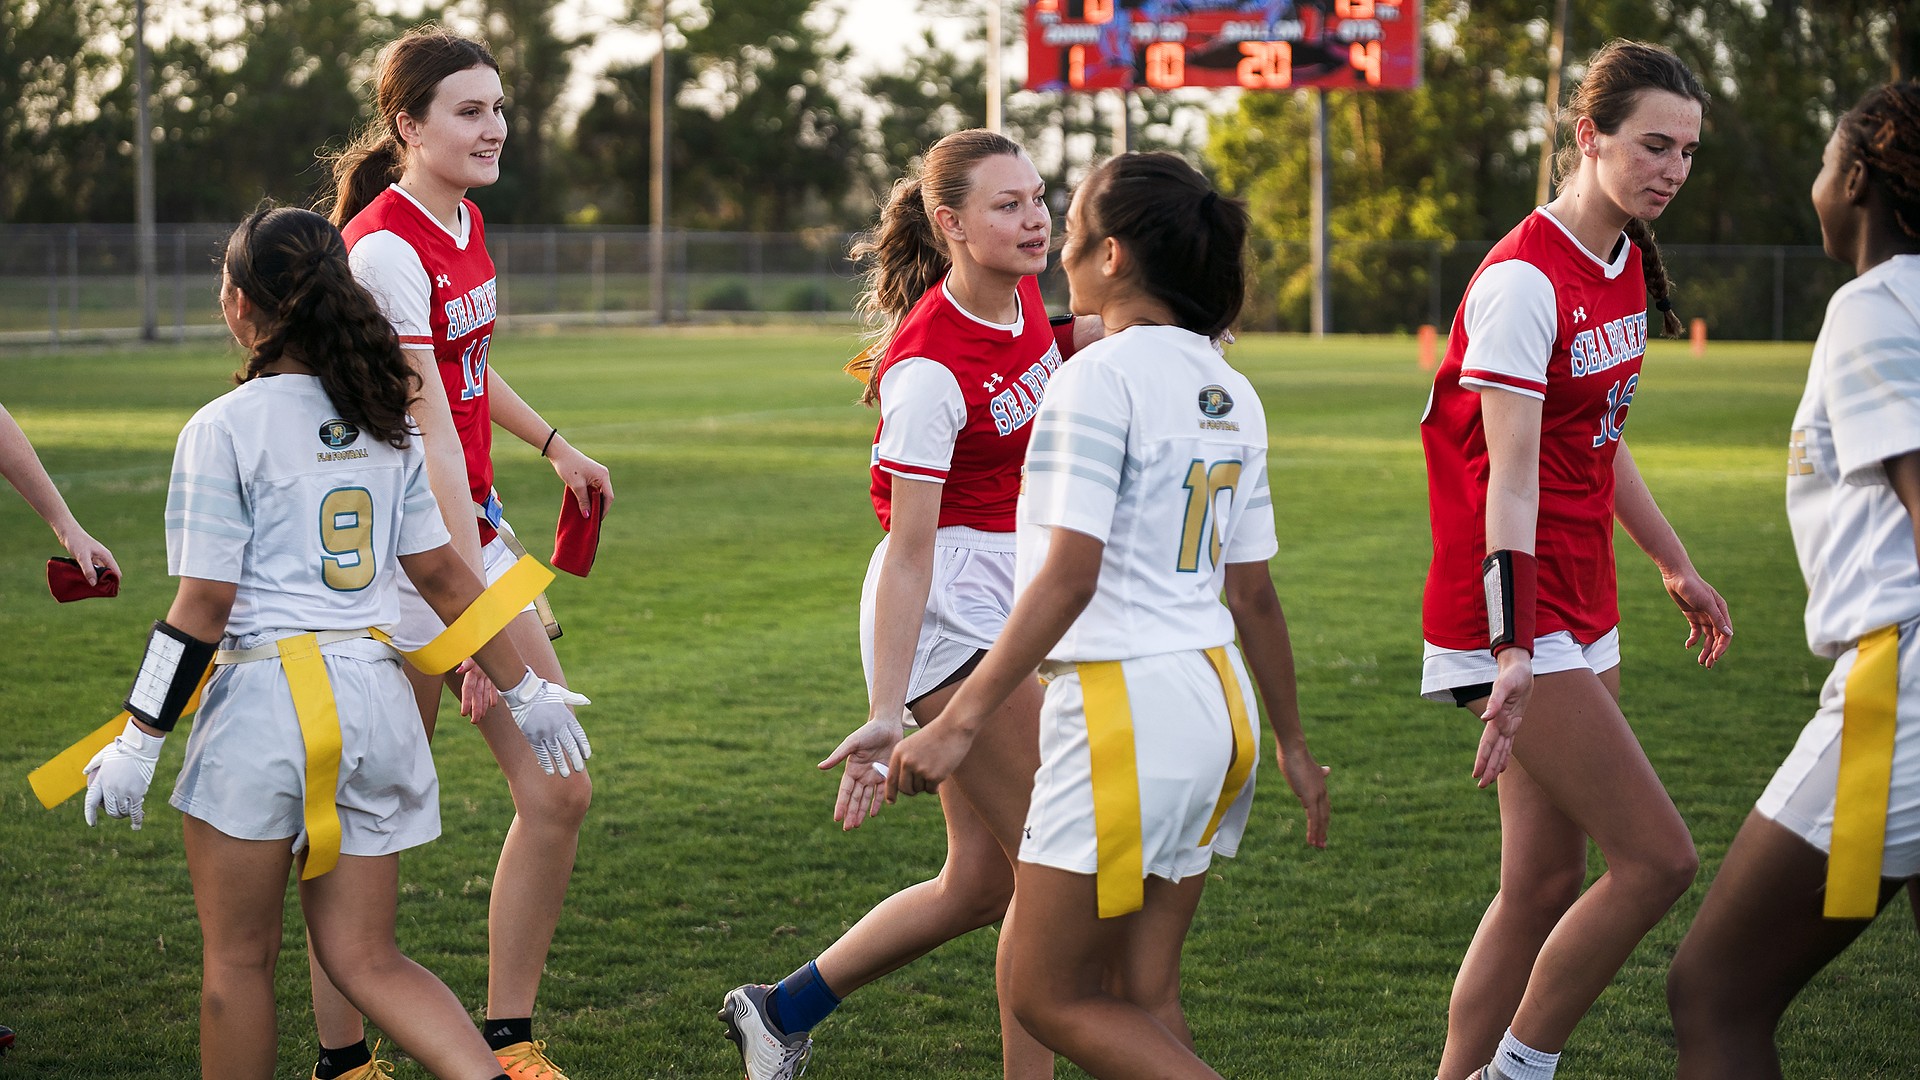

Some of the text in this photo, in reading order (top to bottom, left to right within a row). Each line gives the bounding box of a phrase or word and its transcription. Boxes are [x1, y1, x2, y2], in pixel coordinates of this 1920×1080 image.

[1068, 44, 1086, 89] 1
[1146, 42, 1186, 89] 10
[1237, 41, 1292, 89] 20
[1350, 40, 1382, 87] 4
[1593, 373, 1640, 448] 16
[332, 448, 369, 461] FOOTBALL
[1176, 457, 1243, 573] 10
[319, 486, 376, 592] 9
[762, 1034, 776, 1048] COPA
